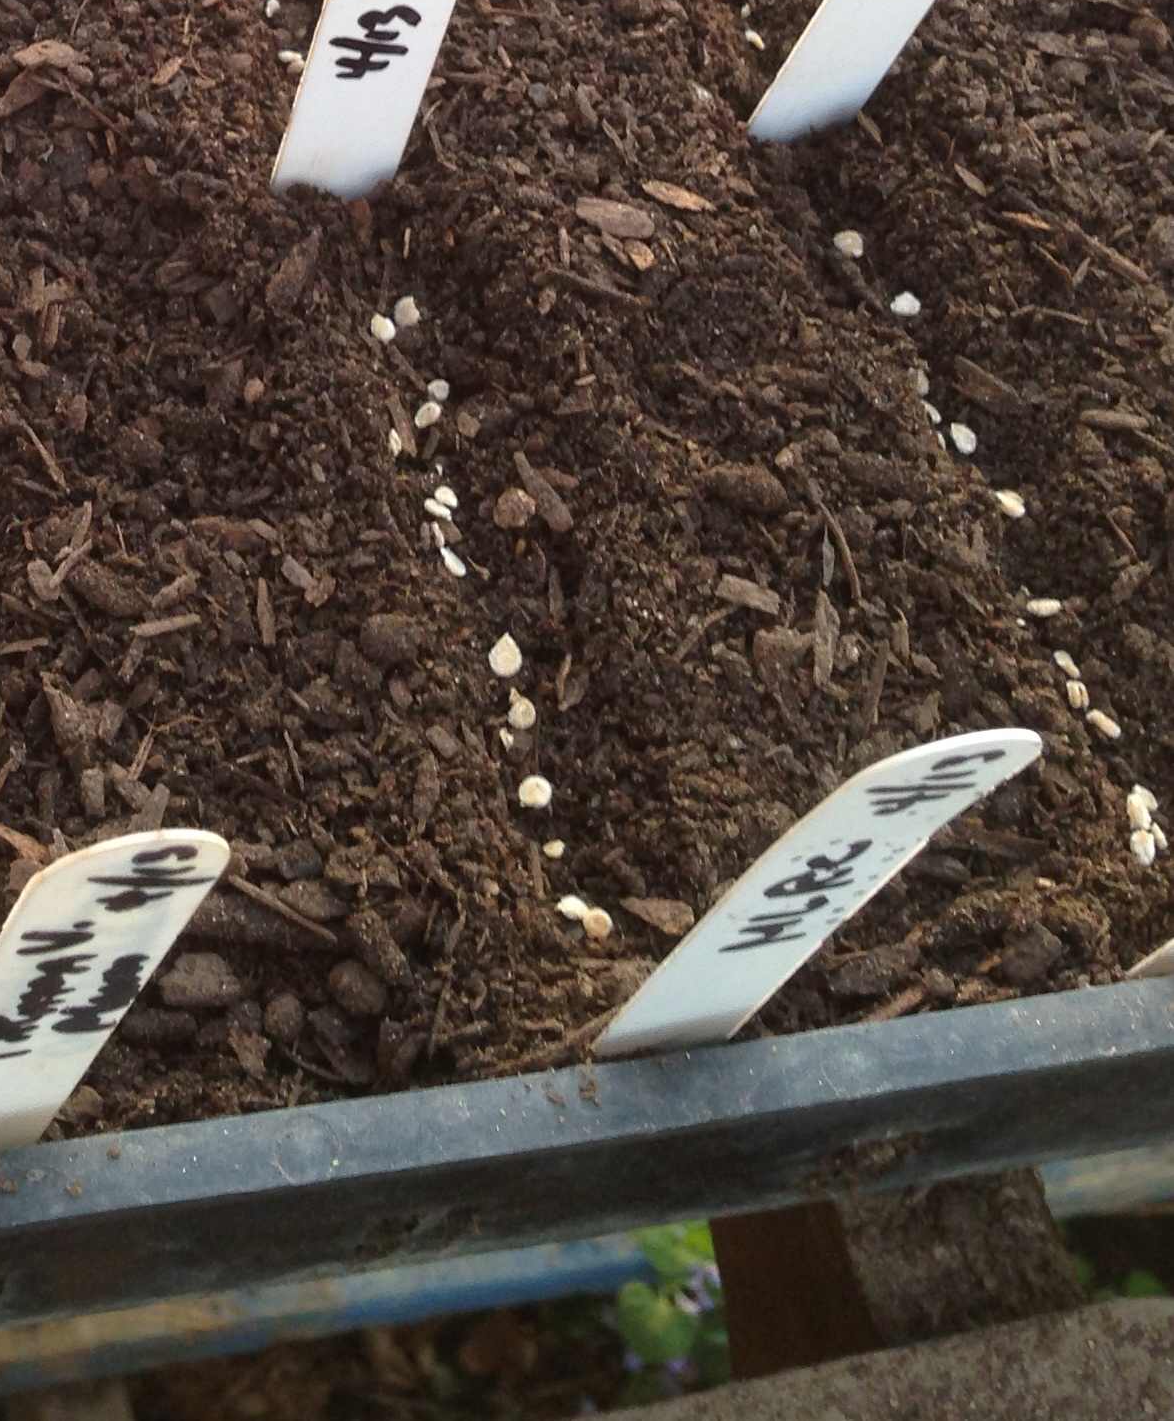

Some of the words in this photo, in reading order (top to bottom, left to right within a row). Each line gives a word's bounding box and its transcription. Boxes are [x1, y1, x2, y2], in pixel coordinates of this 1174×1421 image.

[329, 5, 421, 79] 4/13
[866, 750, 1005, 816] 4/13
[87, 845, 217, 913] 4/13
